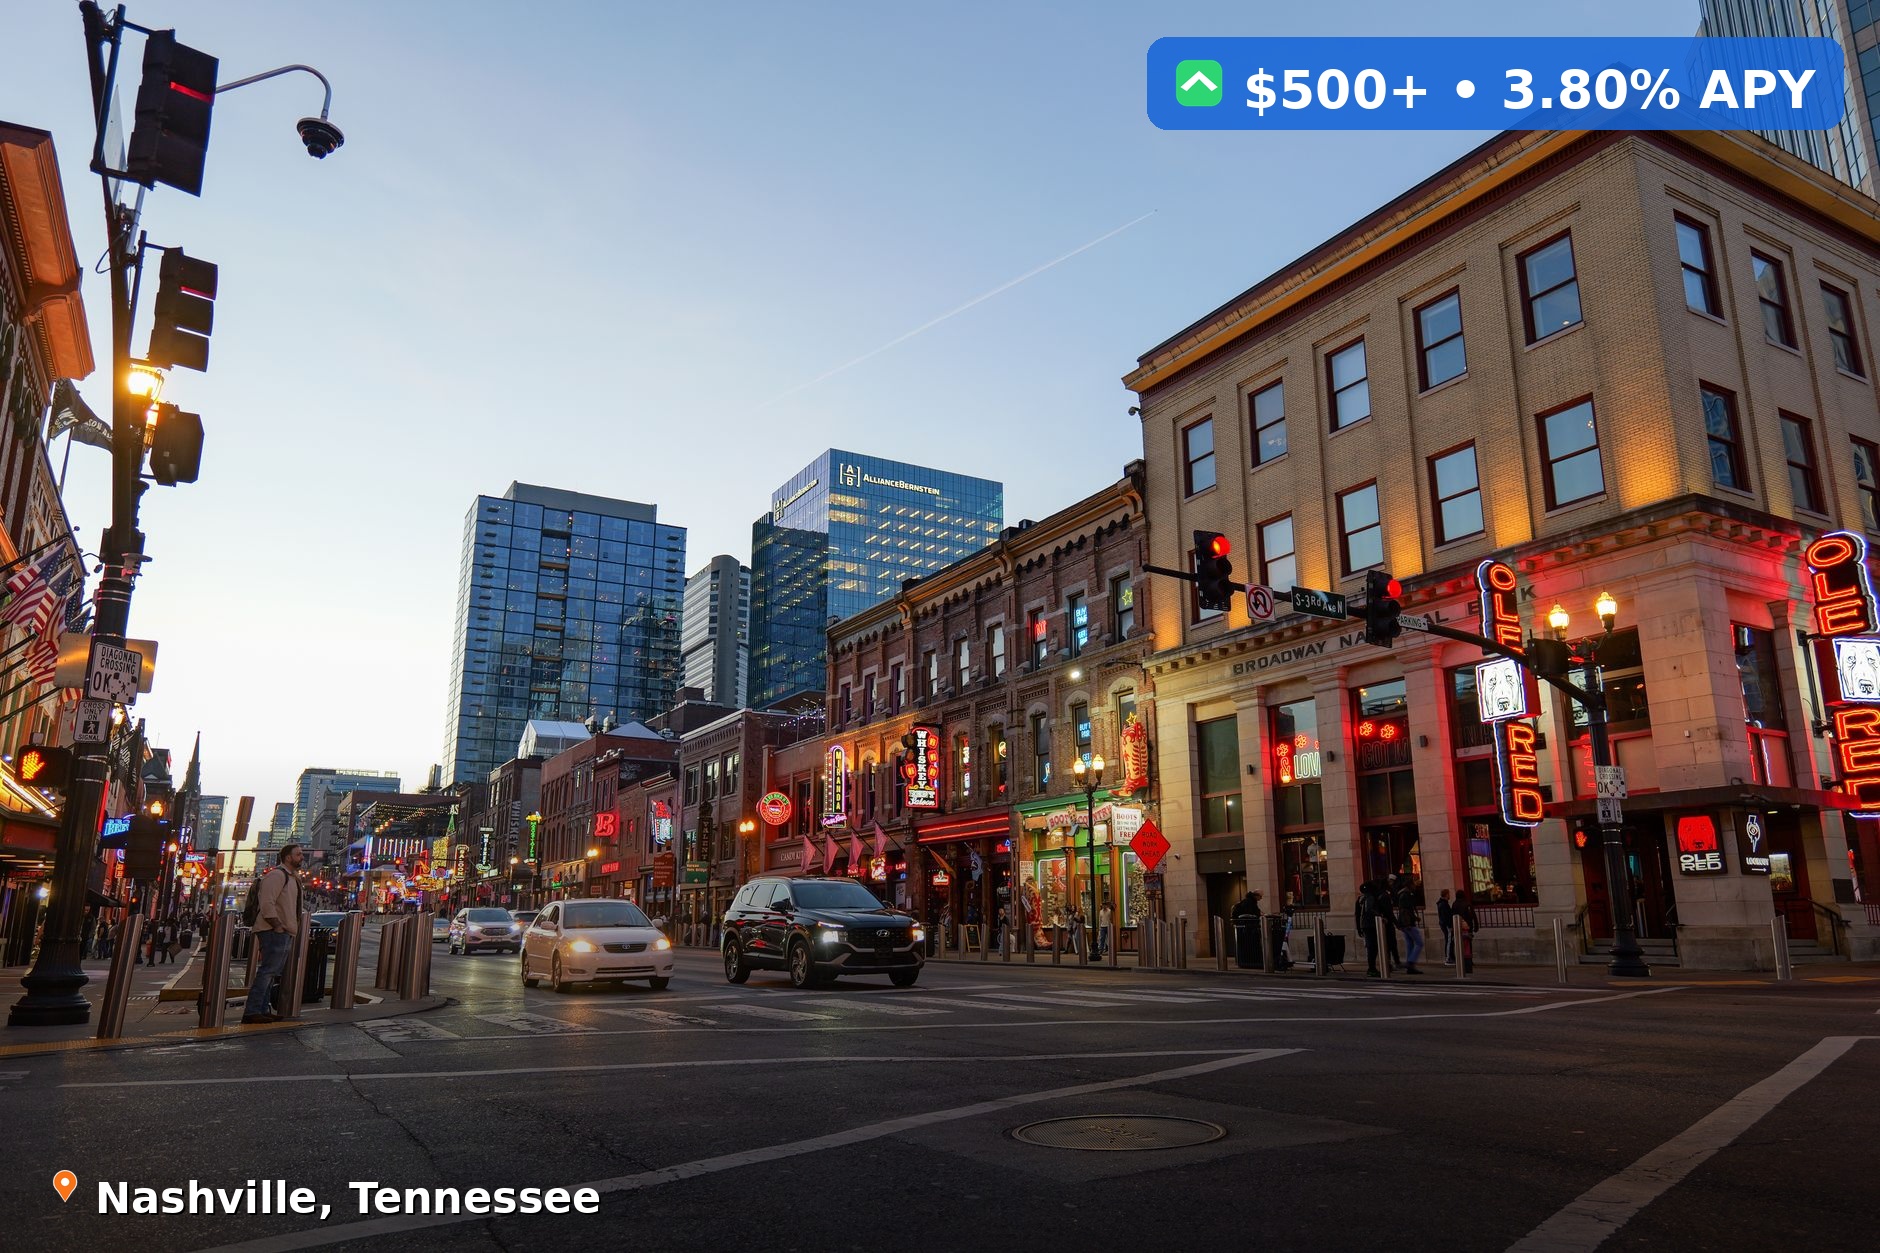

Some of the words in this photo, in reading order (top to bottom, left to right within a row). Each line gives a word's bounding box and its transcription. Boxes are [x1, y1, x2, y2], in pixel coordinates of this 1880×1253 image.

[863, 473, 940, 496] ALLIANCEBERNSTEIN
[1808, 538, 1865, 635] OLE
[1337, 601, 1343, 614] N
[1489, 563, 1524, 653] OLE
[100, 658, 136, 675] CROSSING
[101, 646, 137, 665] DIAGONAL
[1233, 640, 1327, 676] BROADWAY
[93, 671, 112, 693] OK
[916, 730, 928, 789] WHISKEY
[1293, 752, 1322, 780] LOV
[1507, 724, 1543, 820] RED
[1597, 781, 1610, 794] OK
[509, 800, 521, 846] WHISKEY
[1049, 813, 1070, 827] BOOT
[1077, 804, 1112, 824] CONTRY
[1680, 852, 1720, 863] OLE
[1681, 861, 1722, 872] RED
